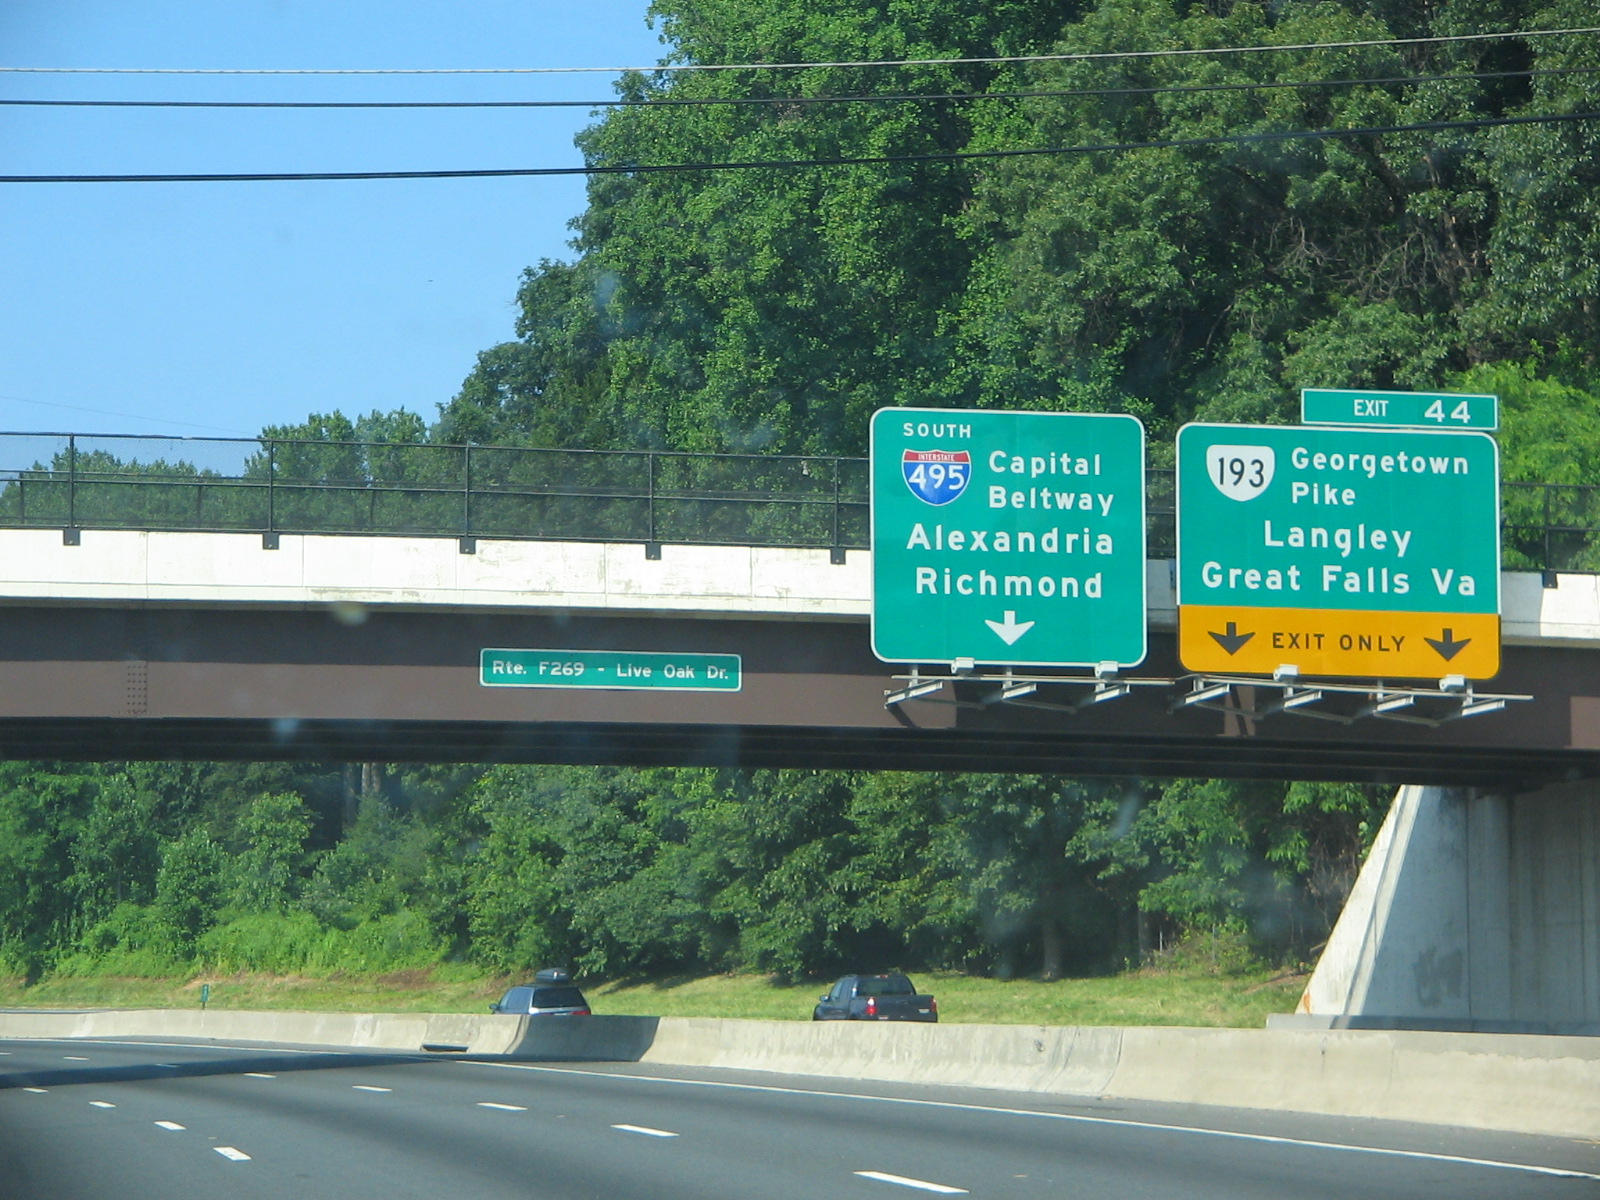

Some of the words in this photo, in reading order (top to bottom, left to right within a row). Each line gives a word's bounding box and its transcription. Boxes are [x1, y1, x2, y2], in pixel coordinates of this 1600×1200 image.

[1353, 399, 1389, 417] EXIT
[1424, 400, 1471, 424] 44
[903, 422, 971, 438] SOUTH
[918, 453, 955, 461] INTERSTATE
[988, 450, 1101, 478] Capital
[1291, 447, 1469, 478] Georgetown
[908, 464, 965, 490] 495
[1218, 457, 1265, 488] 193
[989, 486, 1114, 516] Beltway
[1292, 482, 1356, 505] Pike
[906, 523, 1113, 555] Alexandria
[1264, 520, 1412, 557] Langley
[916, 567, 1102, 598] Richmond
[1202, 561, 1301, 591] Great
[1322, 565, 1410, 594] Falls
[1431, 568, 1475, 596] Va
[1272, 632, 1325, 650] EXIT
[1339, 634, 1406, 652] ONLY
[492, 660, 527, 675] Rte.
[539, 661, 585, 676] F269
[616, 663, 652, 678] Live
[664, 664, 695, 679] Oak
[707, 665, 729, 680] Dr.
